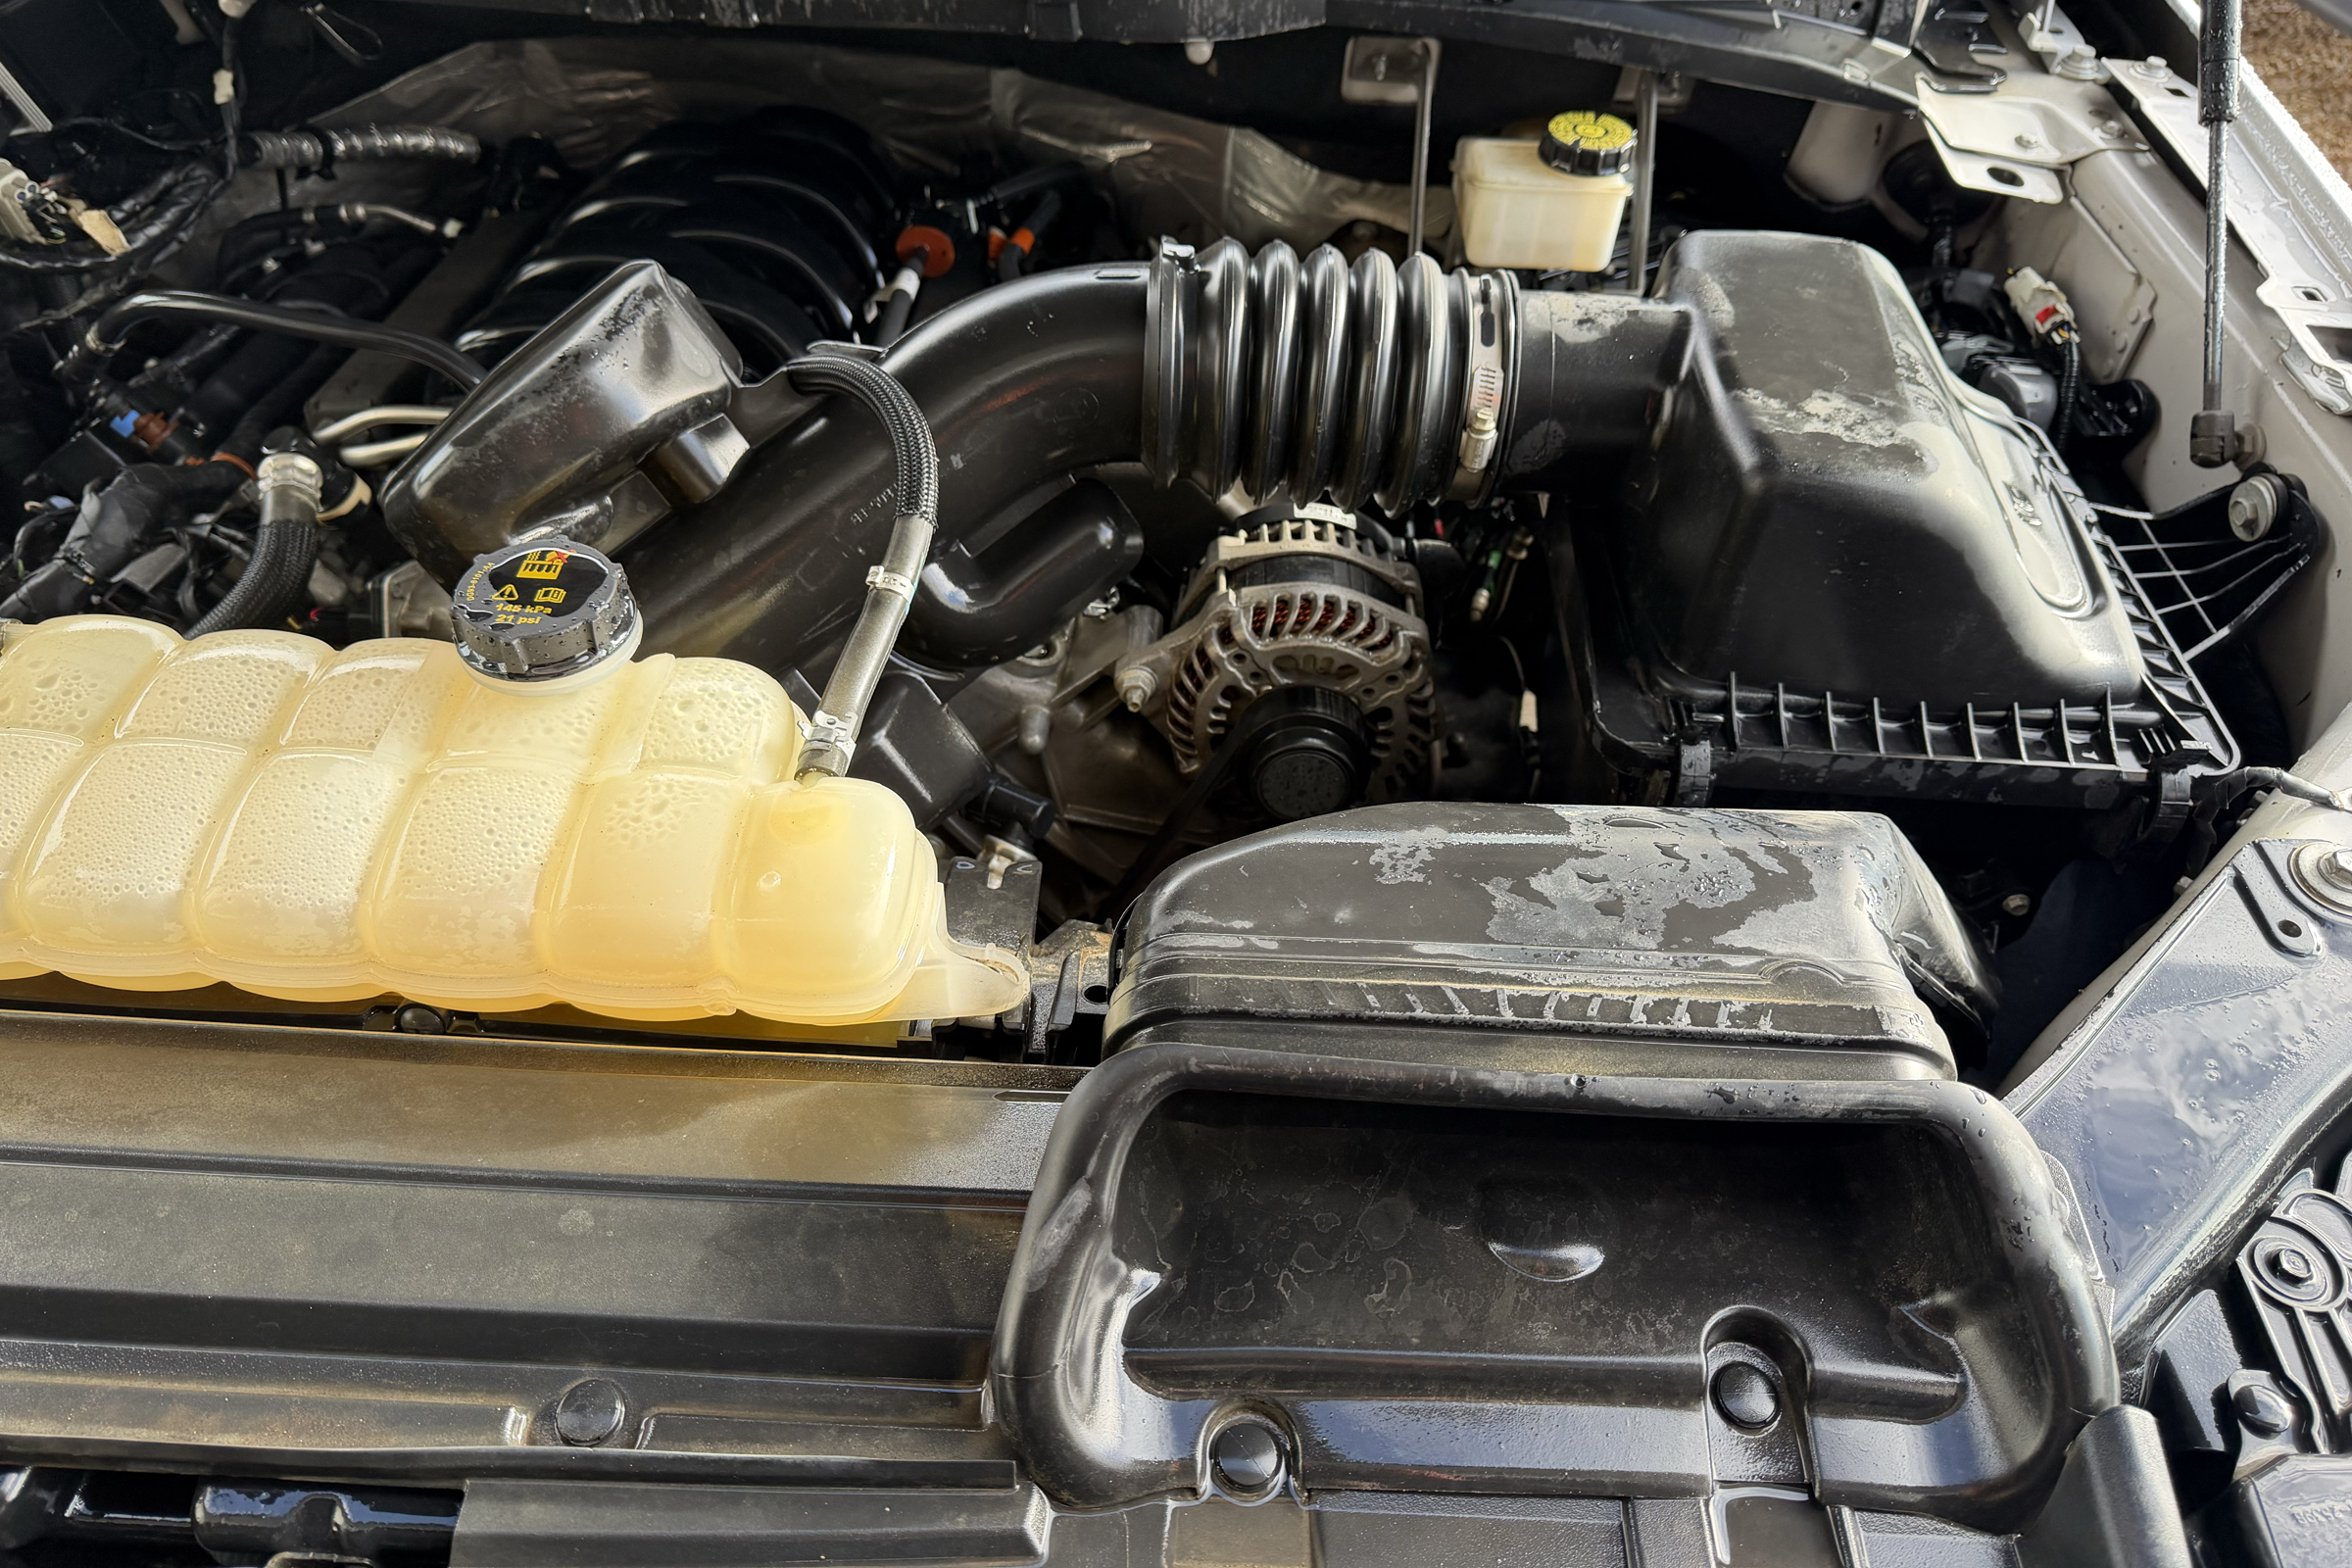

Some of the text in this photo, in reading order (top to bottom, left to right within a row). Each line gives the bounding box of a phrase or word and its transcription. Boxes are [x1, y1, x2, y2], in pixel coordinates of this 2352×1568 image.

[496, 603, 553, 614] 145 kPa
[516, 615, 542, 625] psi
